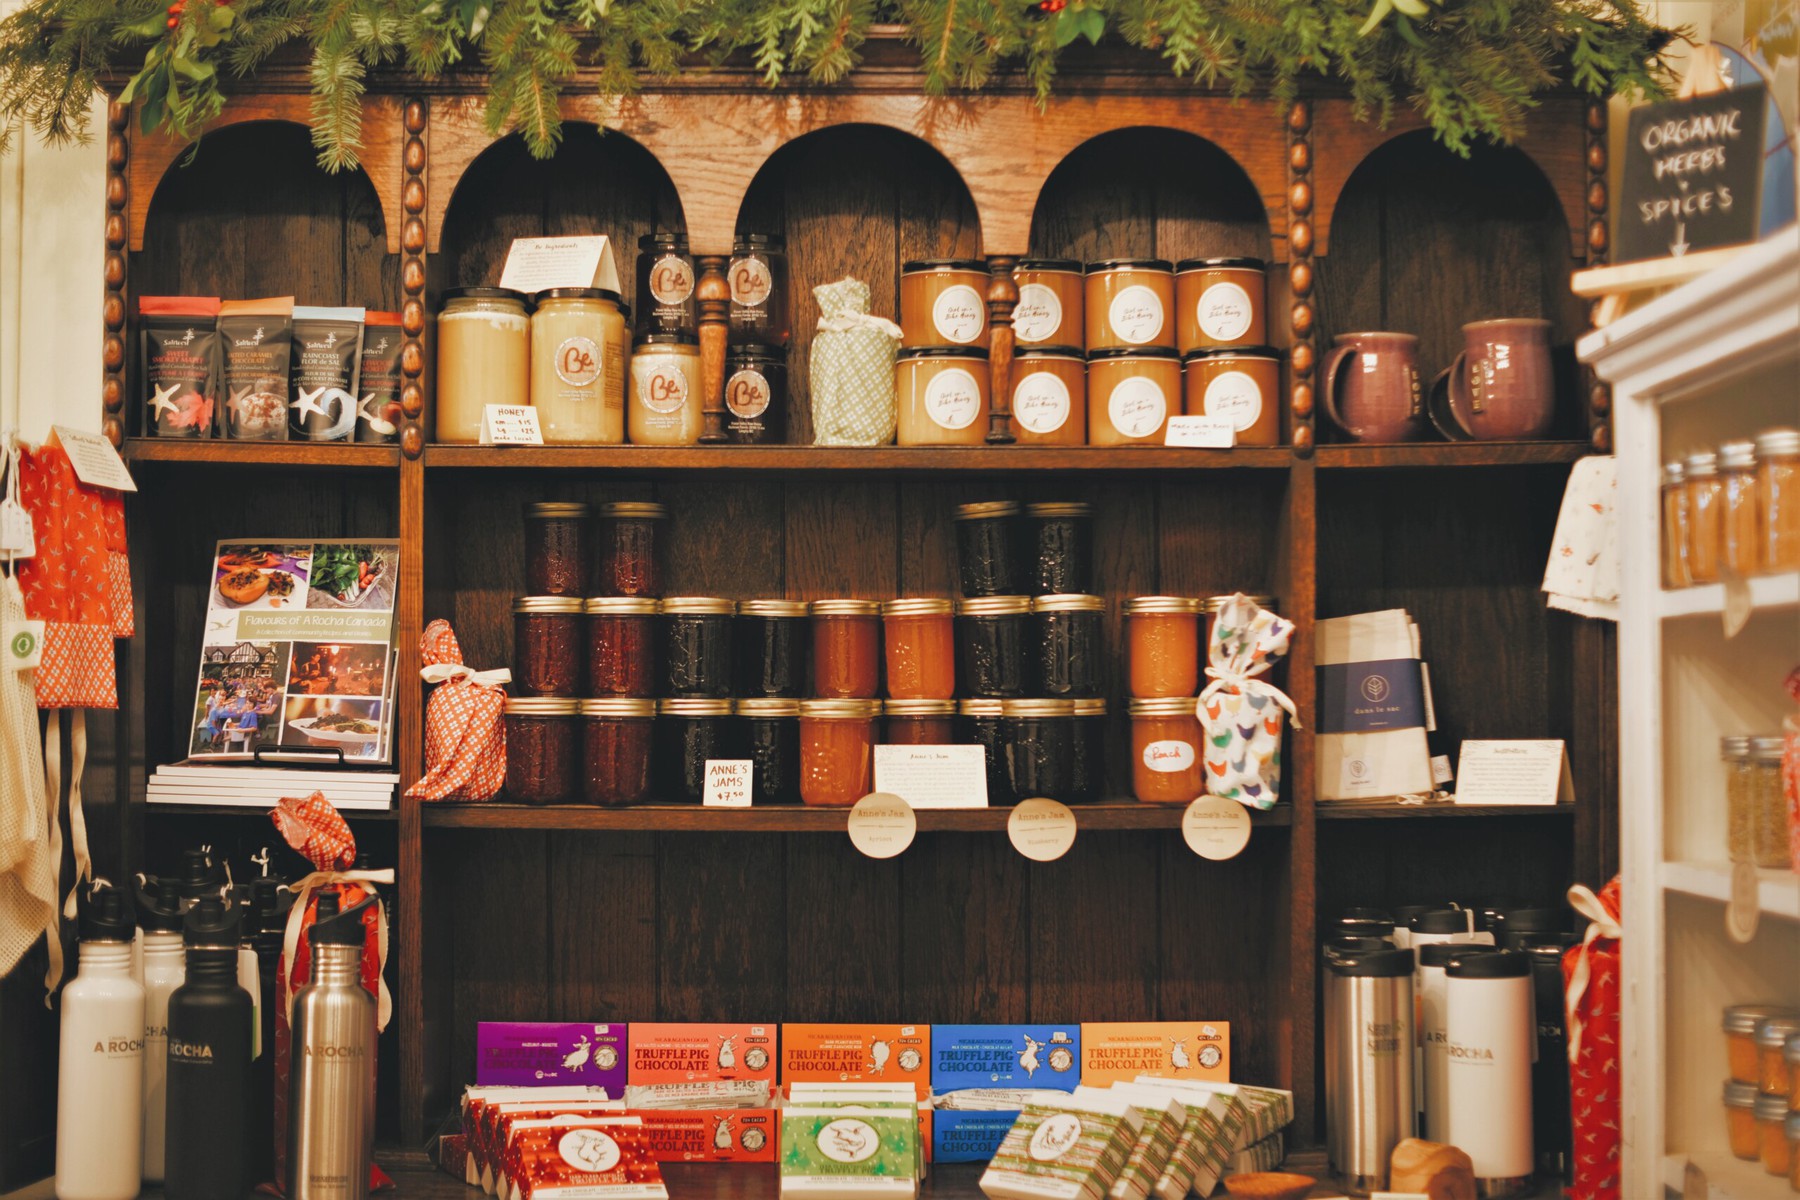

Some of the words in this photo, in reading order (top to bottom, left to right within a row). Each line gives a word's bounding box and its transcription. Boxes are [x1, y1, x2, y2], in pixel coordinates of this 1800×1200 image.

[1642, 109, 1742, 151] ORGANIC
[1655, 145, 1726, 181] HERBS
[1639, 186, 1733, 222] SPICES
[658, 267, 687, 292] Be
[736, 268, 764, 294] Be
[564, 347, 594, 374] Be
[650, 375, 680, 401] Be
[734, 380, 762, 406] Be
[498, 408, 525, 416] HONEY
[245, 616, 287, 625] Flavours
[289, 616, 301, 625] of
[303, 616, 310, 625] A
[312, 616, 344, 625] Rocha
[346, 616, 386, 626] Canada
[710, 764, 747, 776] ANNE'S
[713, 777, 743, 788] JAMS
[1018, 813, 1046, 821] Anne's
[94, 1042, 104, 1052] A
[108, 1039, 144, 1052] ROCH
[170, 1042, 213, 1057] ROCHA
[315, 1046, 364, 1057] ROCHA
[635, 1049, 687, 1059] TRUFFLE
[690, 1049, 709, 1059] PIG
[788, 1050, 841, 1059] TRUFFLE
[843, 1050, 862, 1060] PIG
[939, 1051, 992, 1060] TRUFFLE
[994, 1051, 1014, 1061] PIG
[1088, 1048, 1141, 1058] TRUFFLE
[1143, 1048, 1163, 1058] PIG
[635, 1060, 709, 1070] CHOCOLATE
[788, 1061, 862, 1071] CHOCOLATE
[939, 1062, 1013, 1072] CHOCOLATE
[1088, 1060, 1163, 1070] CHOCOLATE
[685, 1130, 705, 1140] PIG
[942, 1130, 996, 1140] TRUFFLE
[942, 1142, 996, 1152] CHOCOL
